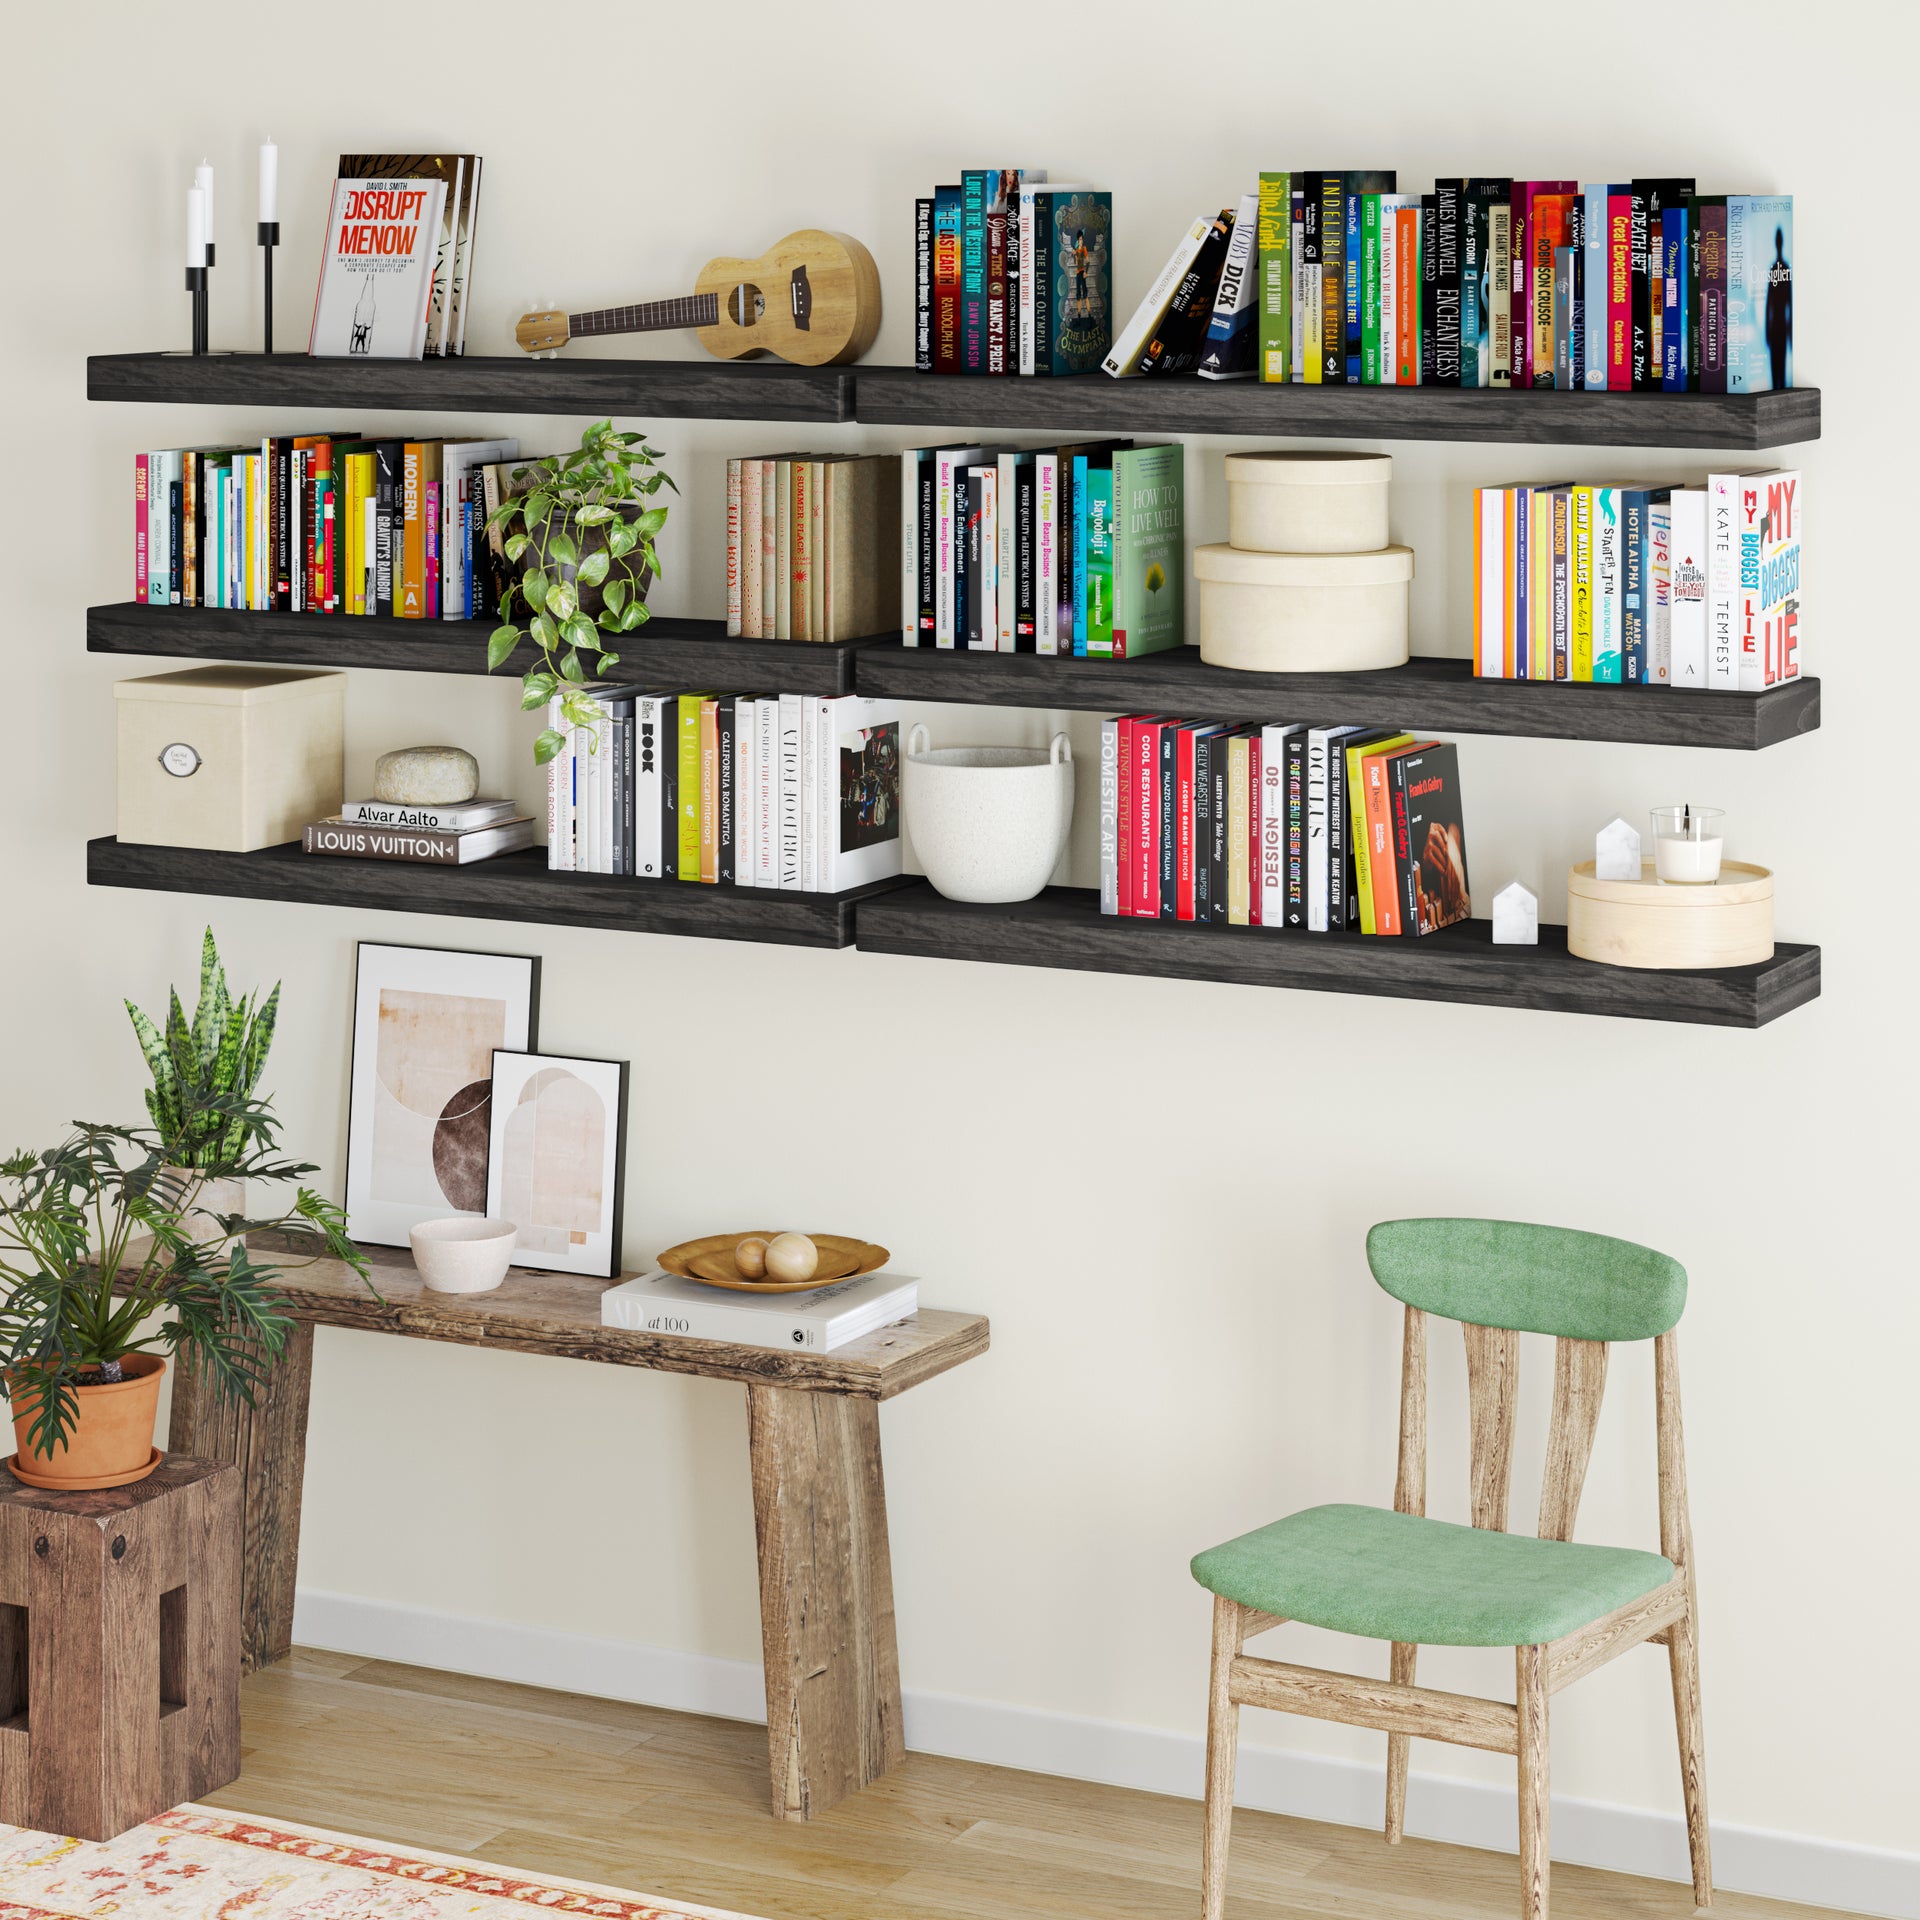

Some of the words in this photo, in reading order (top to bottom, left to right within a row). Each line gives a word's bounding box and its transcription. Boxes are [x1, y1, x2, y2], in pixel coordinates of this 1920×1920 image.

[366, 182, 382, 190] DAVID
[389, 182, 408, 190] SMITH
[966, 176, 983, 195] LOVE
[1631, 196, 1643, 209] the
[344, 191, 427, 220] DISRUPT
[939, 204, 954, 224] THE
[966, 198, 983, 209] ON
[966, 212, 983, 226] THE
[1437, 188, 1456, 220] JAMES
[1465, 203, 1477, 224] Riding
[338, 226, 417, 254] MENOW
[939, 229, 956, 251] LAST
[1021, 217, 1030, 235] THE
[1323, 179, 1340, 267] INDELIBLE
[1348, 218, 1356, 235] Duffy
[1383, 227, 1391, 244] THE
[1465, 226, 1477, 236] the
[1495, 214, 1507, 232] REVOLT
[1612, 216, 1628, 242] Great
[1631, 212, 1646, 250] DEATH
[1731, 205, 1743, 247] RICHARD
[966, 228, 983, 266] WESTERN
[1021, 238, 1030, 271] MONEY
[1036, 248, 1047, 266] THE
[1232, 222, 1255, 260] MOBY
[1439, 224, 1456, 276] MAXWELL
[1465, 238, 1477, 264] STORM
[1495, 234, 1507, 257] AGAINST
[1701, 231, 1725, 279] elegance
[939, 254, 956, 285] EARTH
[1383, 248, 1391, 280] MONEY
[1495, 268, 1507, 291] MADNESS
[1538, 239, 1551, 288] ROBINSON
[1612, 244, 1628, 303] Expectations
[1631, 253, 1646, 274] BET
[1731, 251, 1743, 290] HYTNER
[966, 268, 983, 294] FRONT
[1021, 274, 1030, 308] BUBBLE
[1036, 272, 1047, 296] LAST
[1218, 263, 1244, 308] DICK
[968, 302, 979, 325] DAWN
[1009, 283, 1017, 318] GREGORY
[1383, 283, 1391, 318] BUBBLE
[1538, 290, 1551, 326] CRUSOE
[941, 297, 953, 341] RANDOLPH
[1036, 301, 1047, 352] OLYMPIAN
[1437, 289, 1459, 378] ENCHANTRESS
[941, 343, 953, 359] KAY
[968, 329, 979, 367] JOHNSON
[1009, 320, 1017, 353] MAGUIRE
[137, 467, 146, 501] SCREWED!
[404, 454, 417, 520] MODERN
[485, 477, 494, 505] SHIELD
[956, 484, 965, 512] Digital
[728, 504, 738, 538] THE
[1578, 493, 1589, 530] DANNY
[1744, 491, 1757, 523] MY
[1767, 480, 1796, 543] MY
[377, 516, 390, 558] GRAVITY'S
[1629, 508, 1638, 546] HOTEL
[1717, 508, 1728, 551] KATE
[956, 516, 965, 573] Entanglement
[1578, 534, 1589, 584] WALLACE
[728, 546, 738, 588] BODY
[1556, 563, 1565, 578] THE
[1629, 549, 1638, 590] ALPHA
[1741, 534, 1759, 590] BIGGEST
[1761, 545, 1800, 611] BIGGEST
[377, 561, 390, 601] RAINBOW
[1556, 580, 1565, 631] PSYCHOPATH
[1556, 632, 1565, 651] TEST
[1717, 602, 1728, 674] TEMPEST
[1744, 600, 1756, 652] LIE
[1764, 613, 1797, 686] LIE
[642, 723, 654, 773] BOOK
[1142, 735, 1150, 765] COOL
[1198, 744, 1207, 767] KELLY
[704, 750, 712, 800] Moroccan
[1102, 732, 1114, 824] DOMESTIC
[1233, 749, 1244, 811] REGENCY
[1265, 766, 1278, 787] 80
[1370, 766, 1380, 786] Knoll
[1142, 769, 1150, 848] RESTAURANTS
[1198, 769, 1207, 818] WEARSTLER
[1309, 747, 1324, 838] OCULUS
[1370, 787, 1380, 812] Design
[358, 807, 395, 822] Alvar
[398, 810, 438, 826] Aalto
[704, 802, 712, 844] Interiors
[318, 832, 365, 850] LOUIS
[370, 836, 444, 858] VUITTON
[1102, 831, 1114, 863] ART
[1233, 816, 1244, 860] REDUX
[1265, 817, 1278, 887] DESIGN
[648, 1318, 660, 1329] at
[664, 1317, 689, 1333] 100
